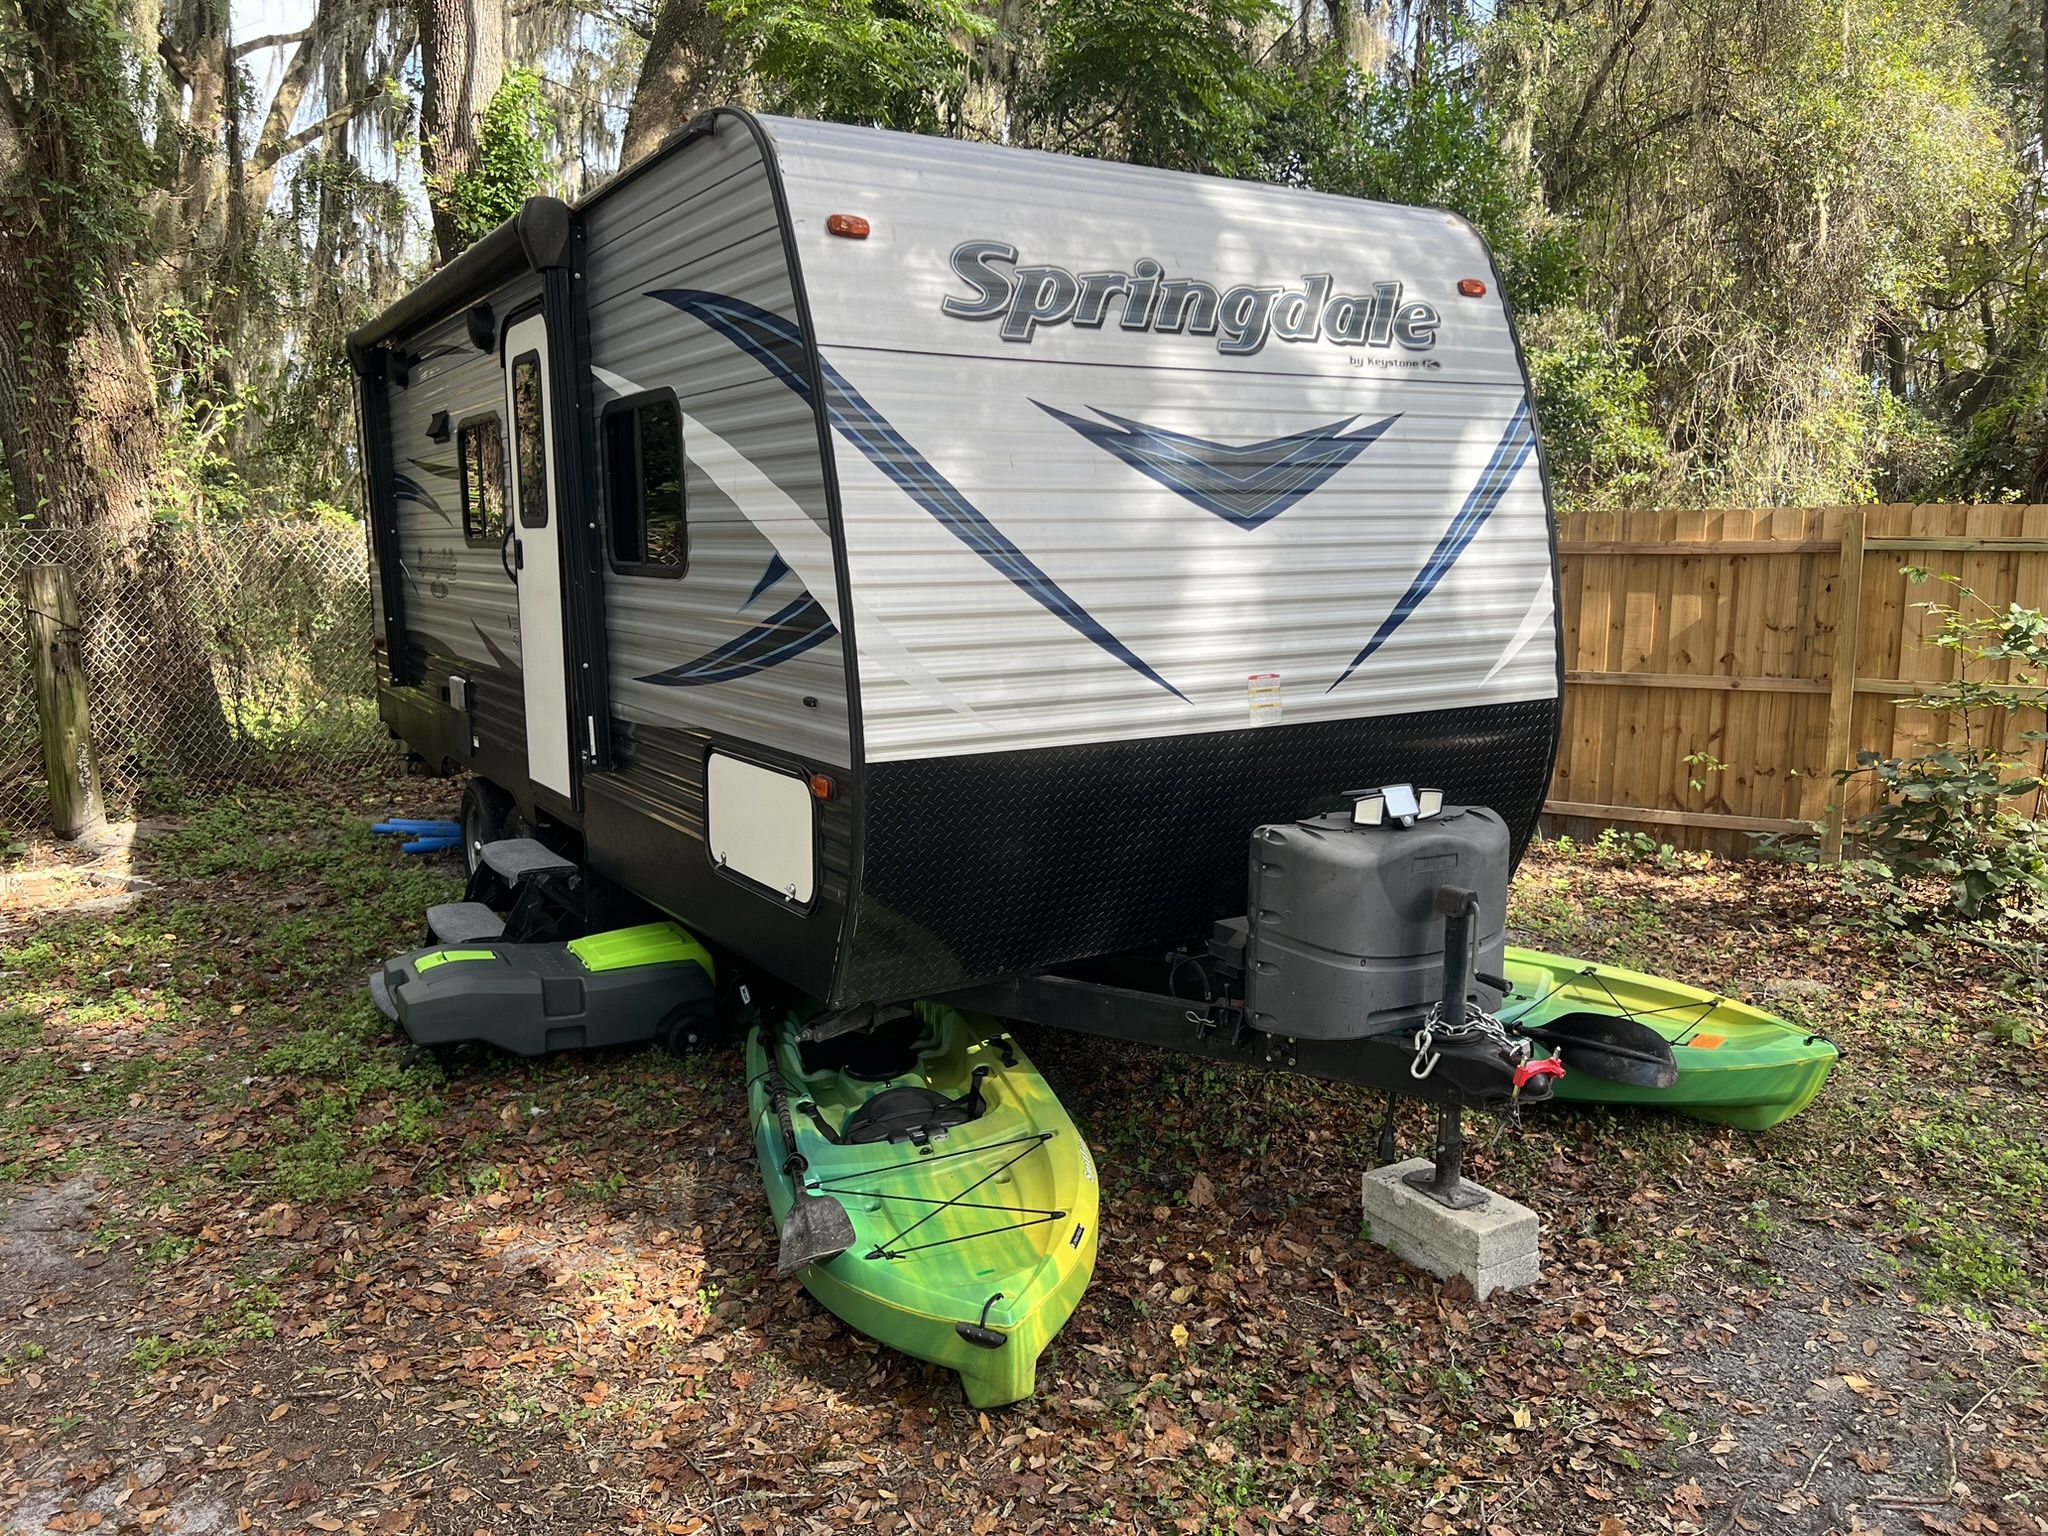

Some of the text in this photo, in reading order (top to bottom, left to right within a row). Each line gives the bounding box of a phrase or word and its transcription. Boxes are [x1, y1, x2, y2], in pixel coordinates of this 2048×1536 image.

[942, 239, 1441, 355] Springdale
[1349, 356, 1420, 369] by Keystone
